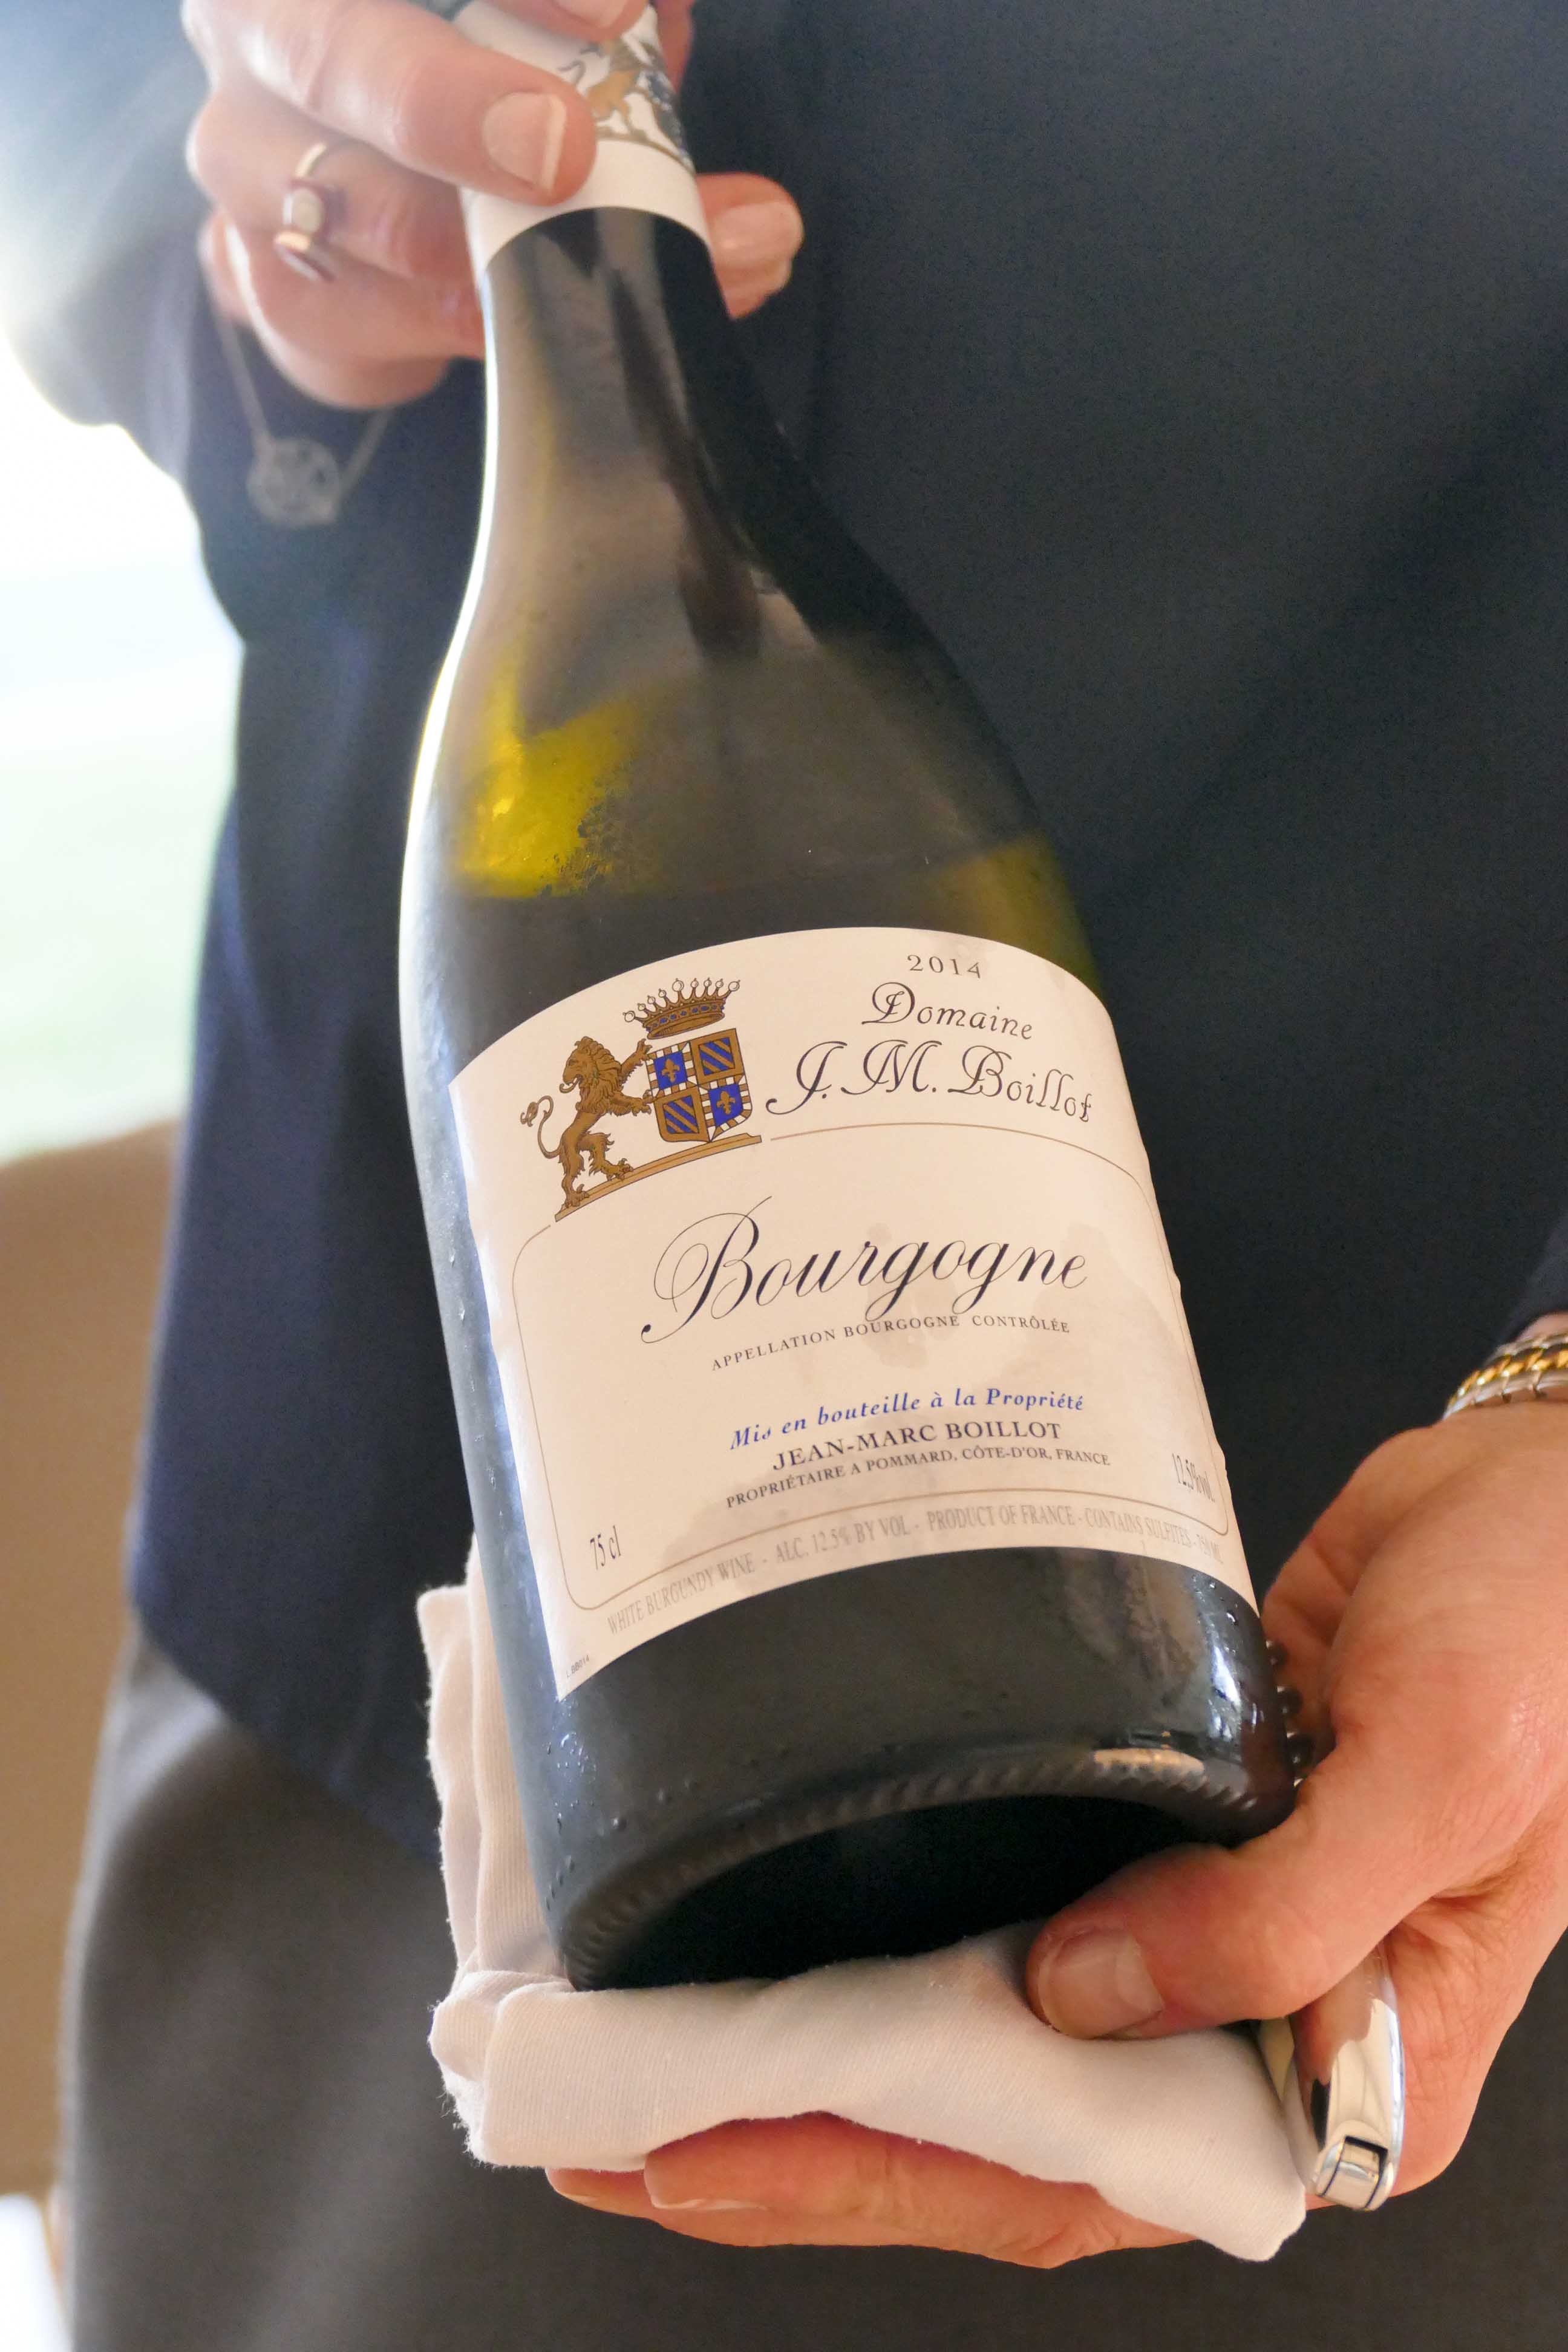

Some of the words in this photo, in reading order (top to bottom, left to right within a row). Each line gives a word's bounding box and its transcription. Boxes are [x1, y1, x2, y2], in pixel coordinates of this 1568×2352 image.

[908, 954, 981, 979] 2014
[861, 982, 1033, 1040] Domaine
[947, 1045, 1093, 1123] Boillot
[641, 1196, 1088, 1343] Bourgogne
[712, 1328, 836, 1371] APPELLATION
[843, 1315, 960, 1338] BOURGOGNE
[972, 1315, 1070, 1333] CONTRÔLÉE
[730, 1423, 771, 1449] Mis
[782, 1417, 806, 1434] en
[818, 1392, 920, 1425] bouteille
[930, 1391, 943, 1408] à
[955, 1388, 975, 1406] la
[985, 1388, 1085, 1411] Propriété
[773, 1424, 938, 1471] JEAN-MARC
[944, 1420, 1062, 1440] BOILLOT
[727, 1465, 846, 1508] PROPRIÉTAIRE
[851, 1463, 861, 1475] A
[1056, 1448, 1111, 1466] FRANCE
[589, 1534, 606, 1570] 75
[609, 1524, 621, 1560] cl
[607, 1601, 645, 1635] WHITE
[645, 1567, 715, 1616] BURGUNDY
[717, 1552, 756, 1581] WINE
[854, 1520, 876, 1543] BY
[927, 1505, 996, 1532] PRODUCT
[999, 1504, 1017, 1526] OF
[1020, 1504, 1075, 1526] FRANCE
[1083, 1507, 1145, 1534] CONTAINS
[1144, 1517, 1192, 1549] SULFITES
